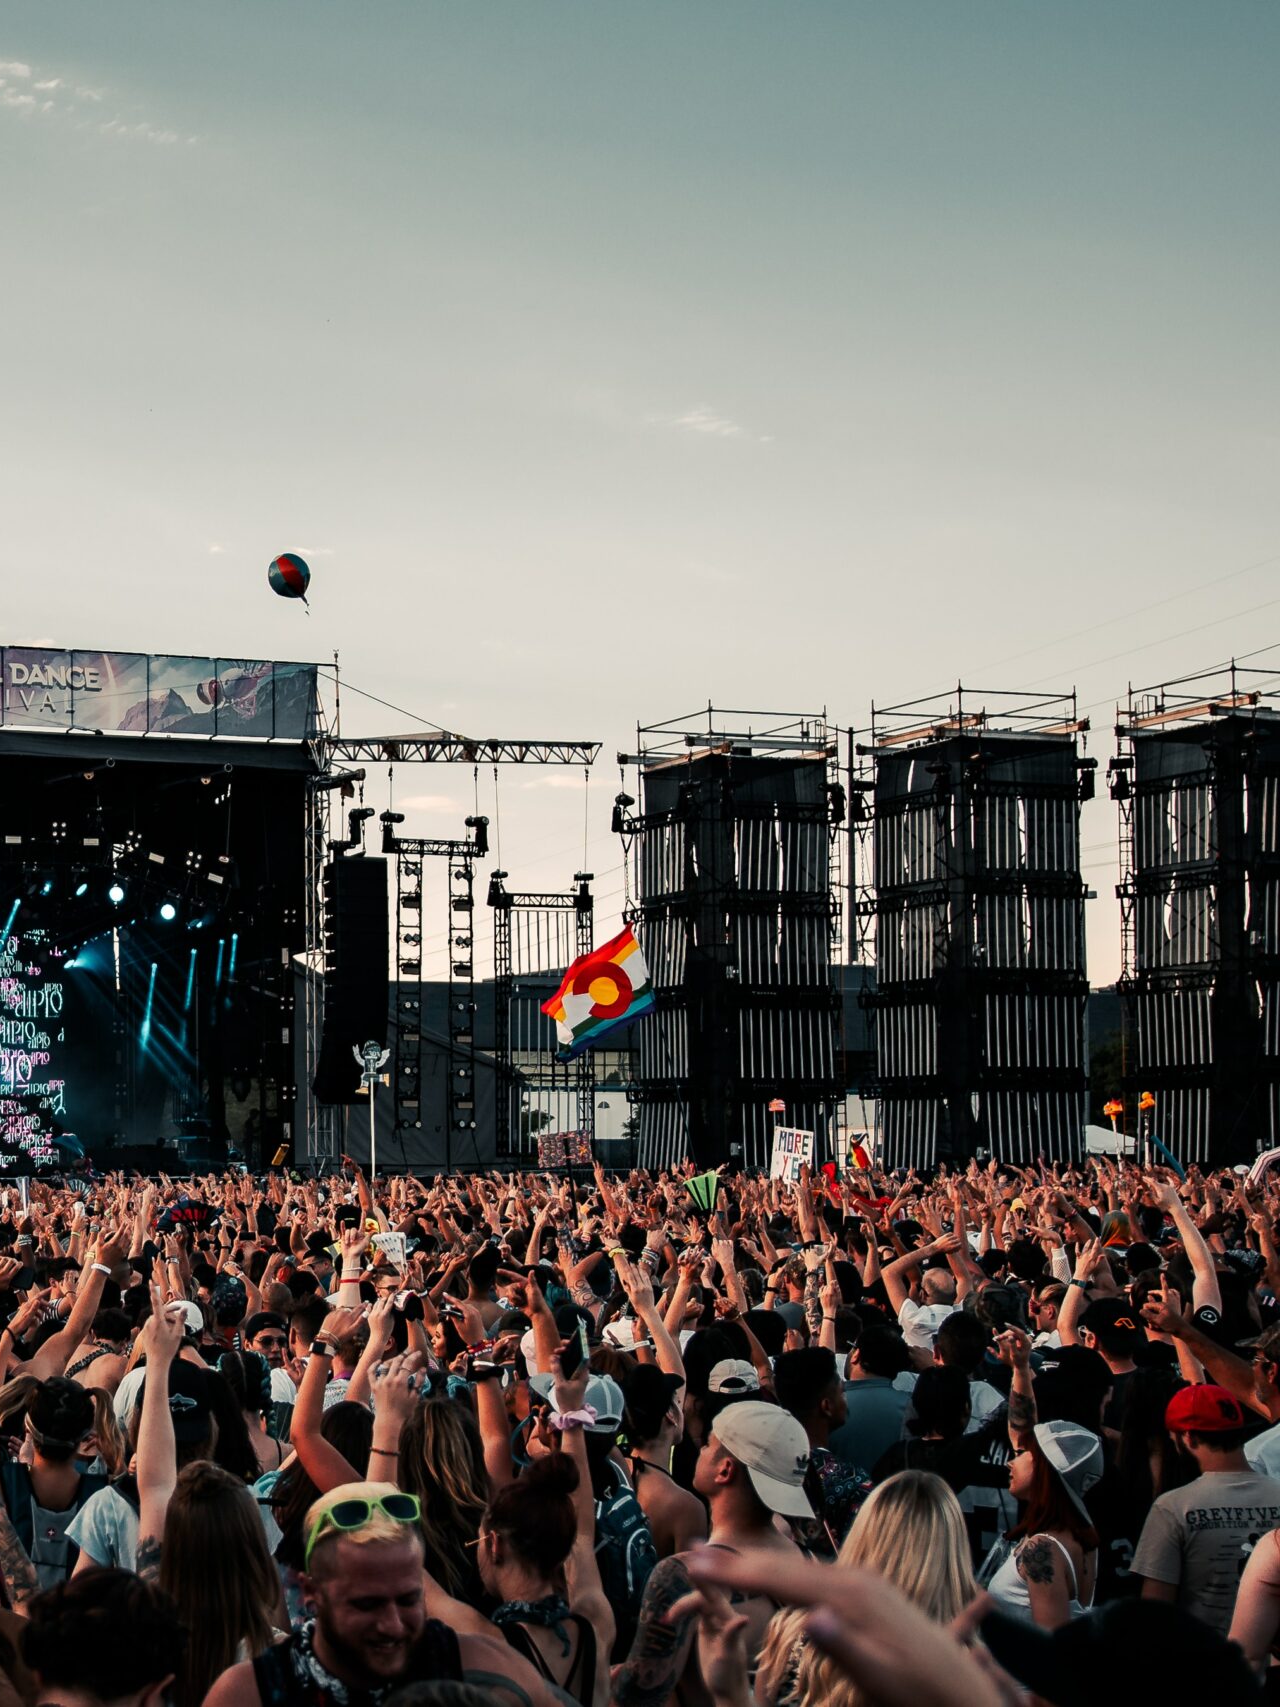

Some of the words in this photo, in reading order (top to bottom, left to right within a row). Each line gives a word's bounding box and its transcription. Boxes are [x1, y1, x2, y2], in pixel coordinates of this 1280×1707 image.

[9, 661, 102, 691] DANCE
[778, 1131, 810, 1155] MORE
[782, 1155, 811, 1181] YE
[1185, 1506, 1280, 1525] GREYFIVE
[1190, 1520, 1250, 1533] AMMUNITION
[1255, 1520, 1274, 1529] AND
